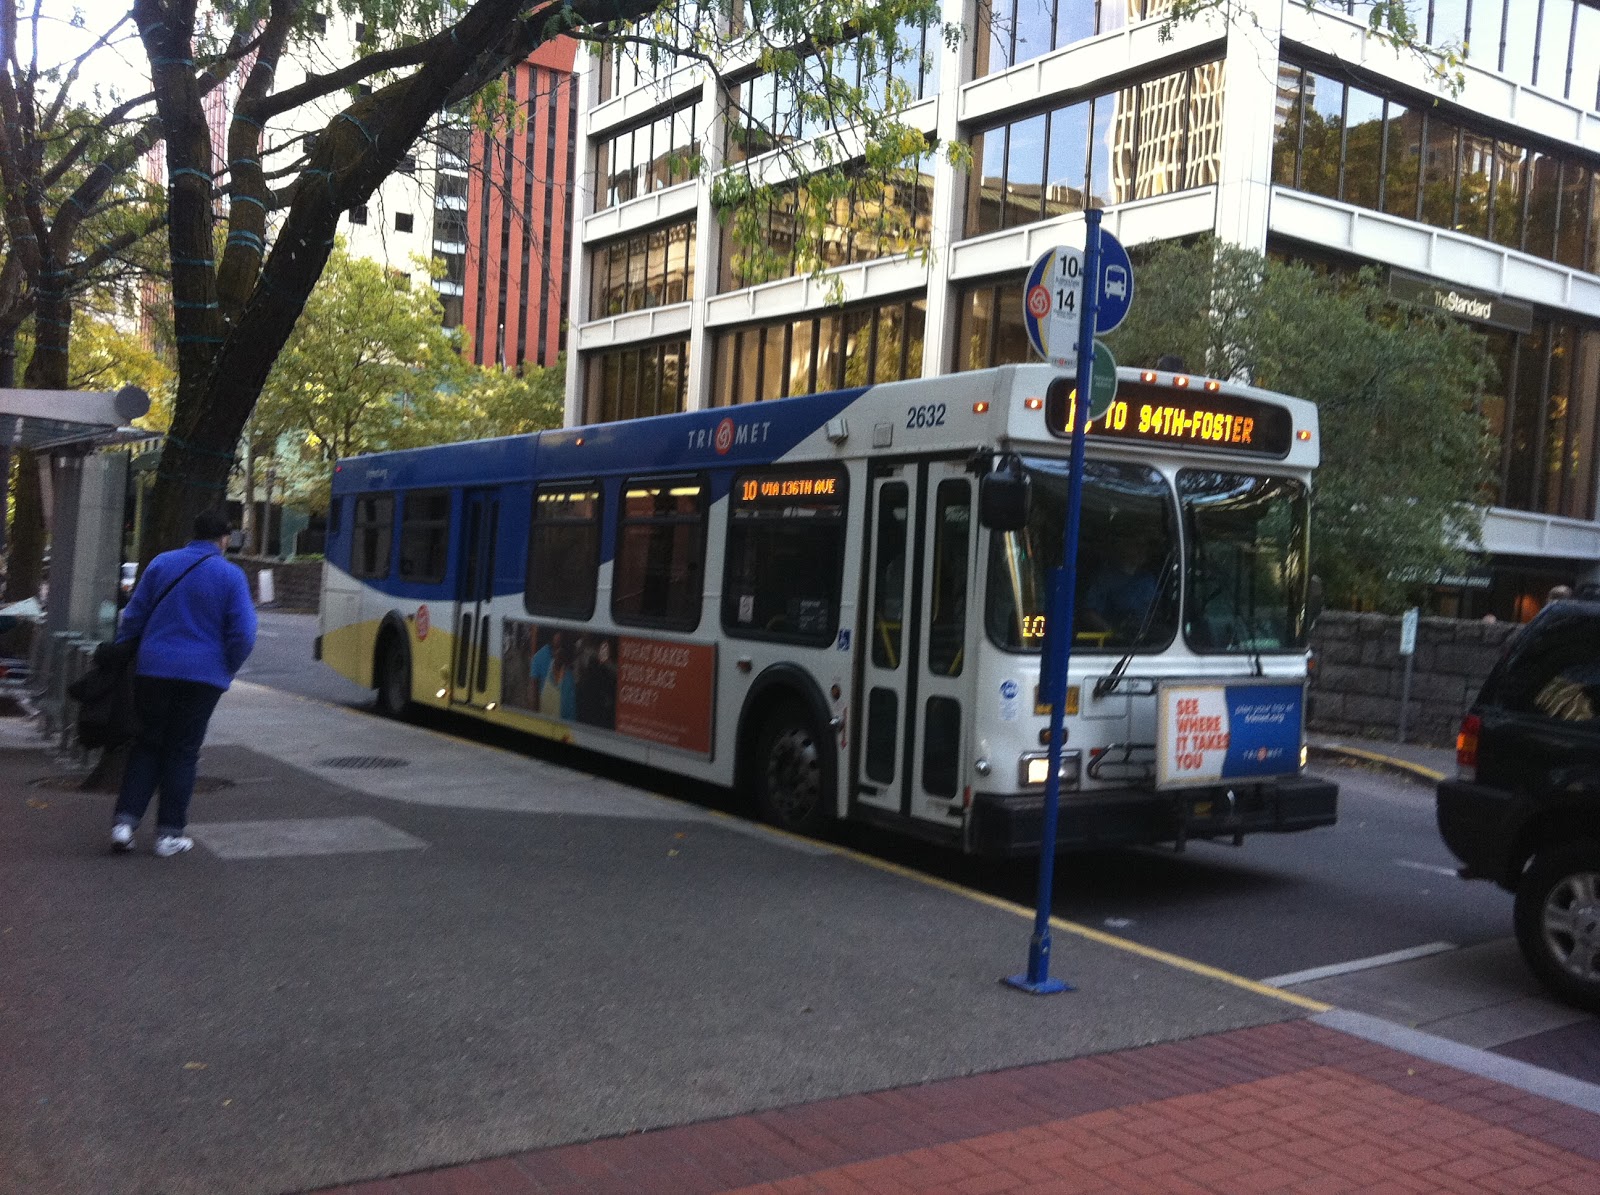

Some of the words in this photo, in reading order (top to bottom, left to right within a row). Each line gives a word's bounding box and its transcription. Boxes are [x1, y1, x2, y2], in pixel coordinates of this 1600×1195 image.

[1060, 254, 1078, 278] 10
[1056, 288, 1075, 312] 14
[906, 403, 946, 429] 2632
[1138, 404, 1254, 444] 94TH-FOSTER
[742, 480, 758, 500] 10
[761, 481, 780, 496] VIA
[781, 480, 813, 496] 136TH
[814, 478, 836, 495] AVE
[1022, 615, 1046, 637] 10
[1176, 698, 1200, 716] SEE
[1176, 715, 1222, 733] WHERE
[1176, 735, 1189, 752] IT
[1192, 732, 1231, 751] TAKES
[1176, 752, 1204, 771] YOU
